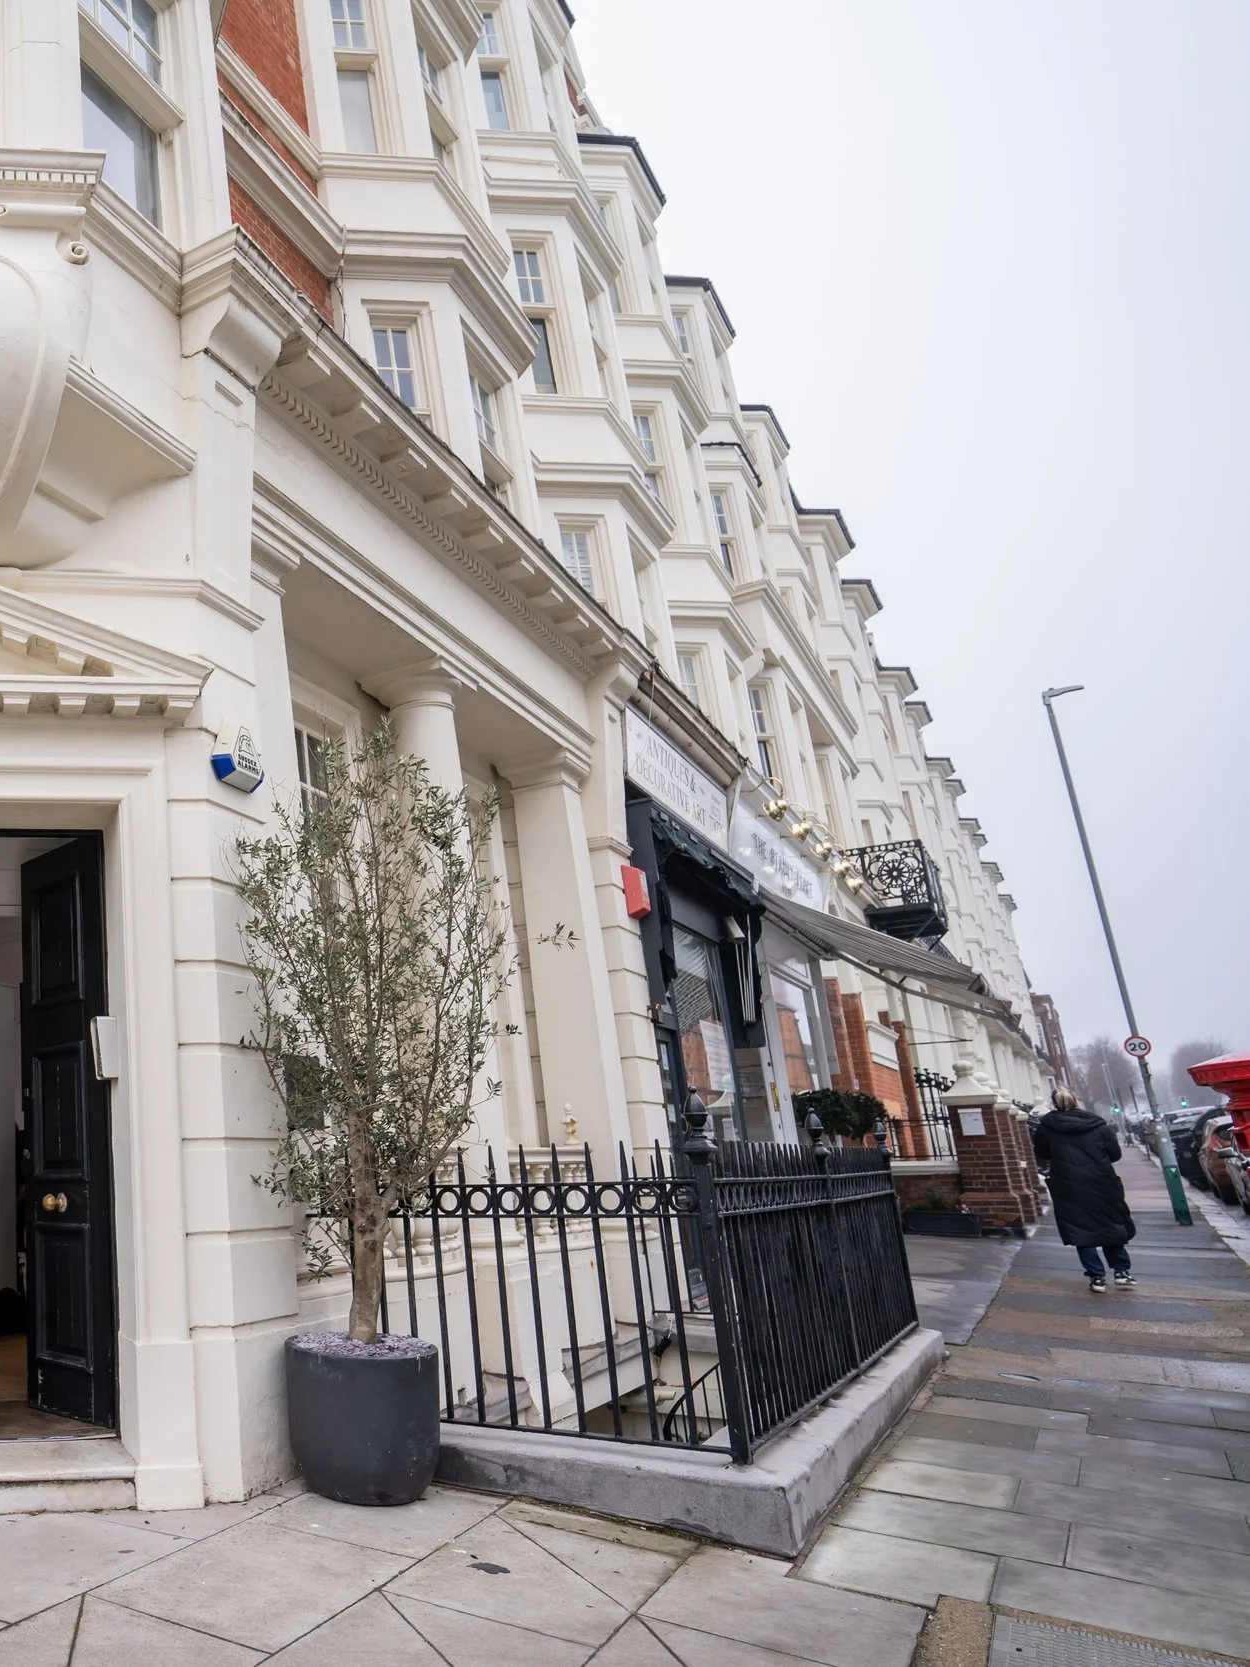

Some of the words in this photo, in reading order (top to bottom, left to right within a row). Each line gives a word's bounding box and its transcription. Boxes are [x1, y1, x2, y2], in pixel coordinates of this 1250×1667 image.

[238, 754, 257, 767] SUSSEX
[238, 760, 259, 774] ALARMS
[647, 737, 689, 787] ANTIQUES
[635, 752, 690, 814] DECORATIVE
[692, 803, 706, 826] ART
[1128, 1042, 1147, 1051] 20
